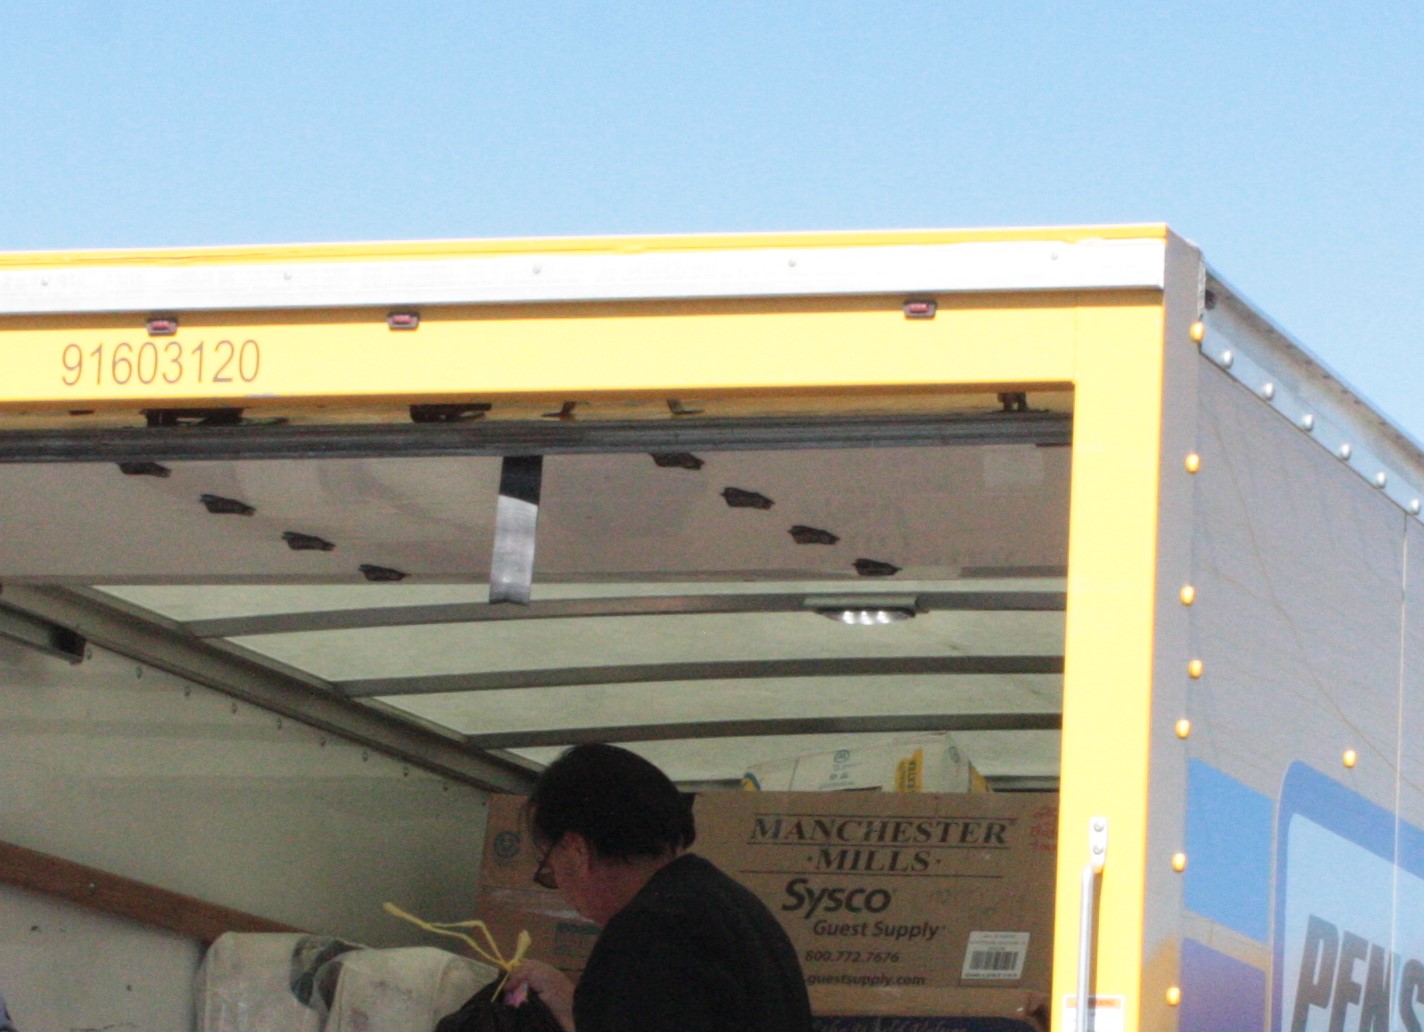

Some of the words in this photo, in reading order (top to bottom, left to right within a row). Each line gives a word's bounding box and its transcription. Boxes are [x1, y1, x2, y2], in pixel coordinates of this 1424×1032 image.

[62, 340, 261, 386] 91603120
[750, 818, 1008, 845] MANCHESTER
[813, 919, 868, 938] Guest
[872, 920, 940, 941] Supply
